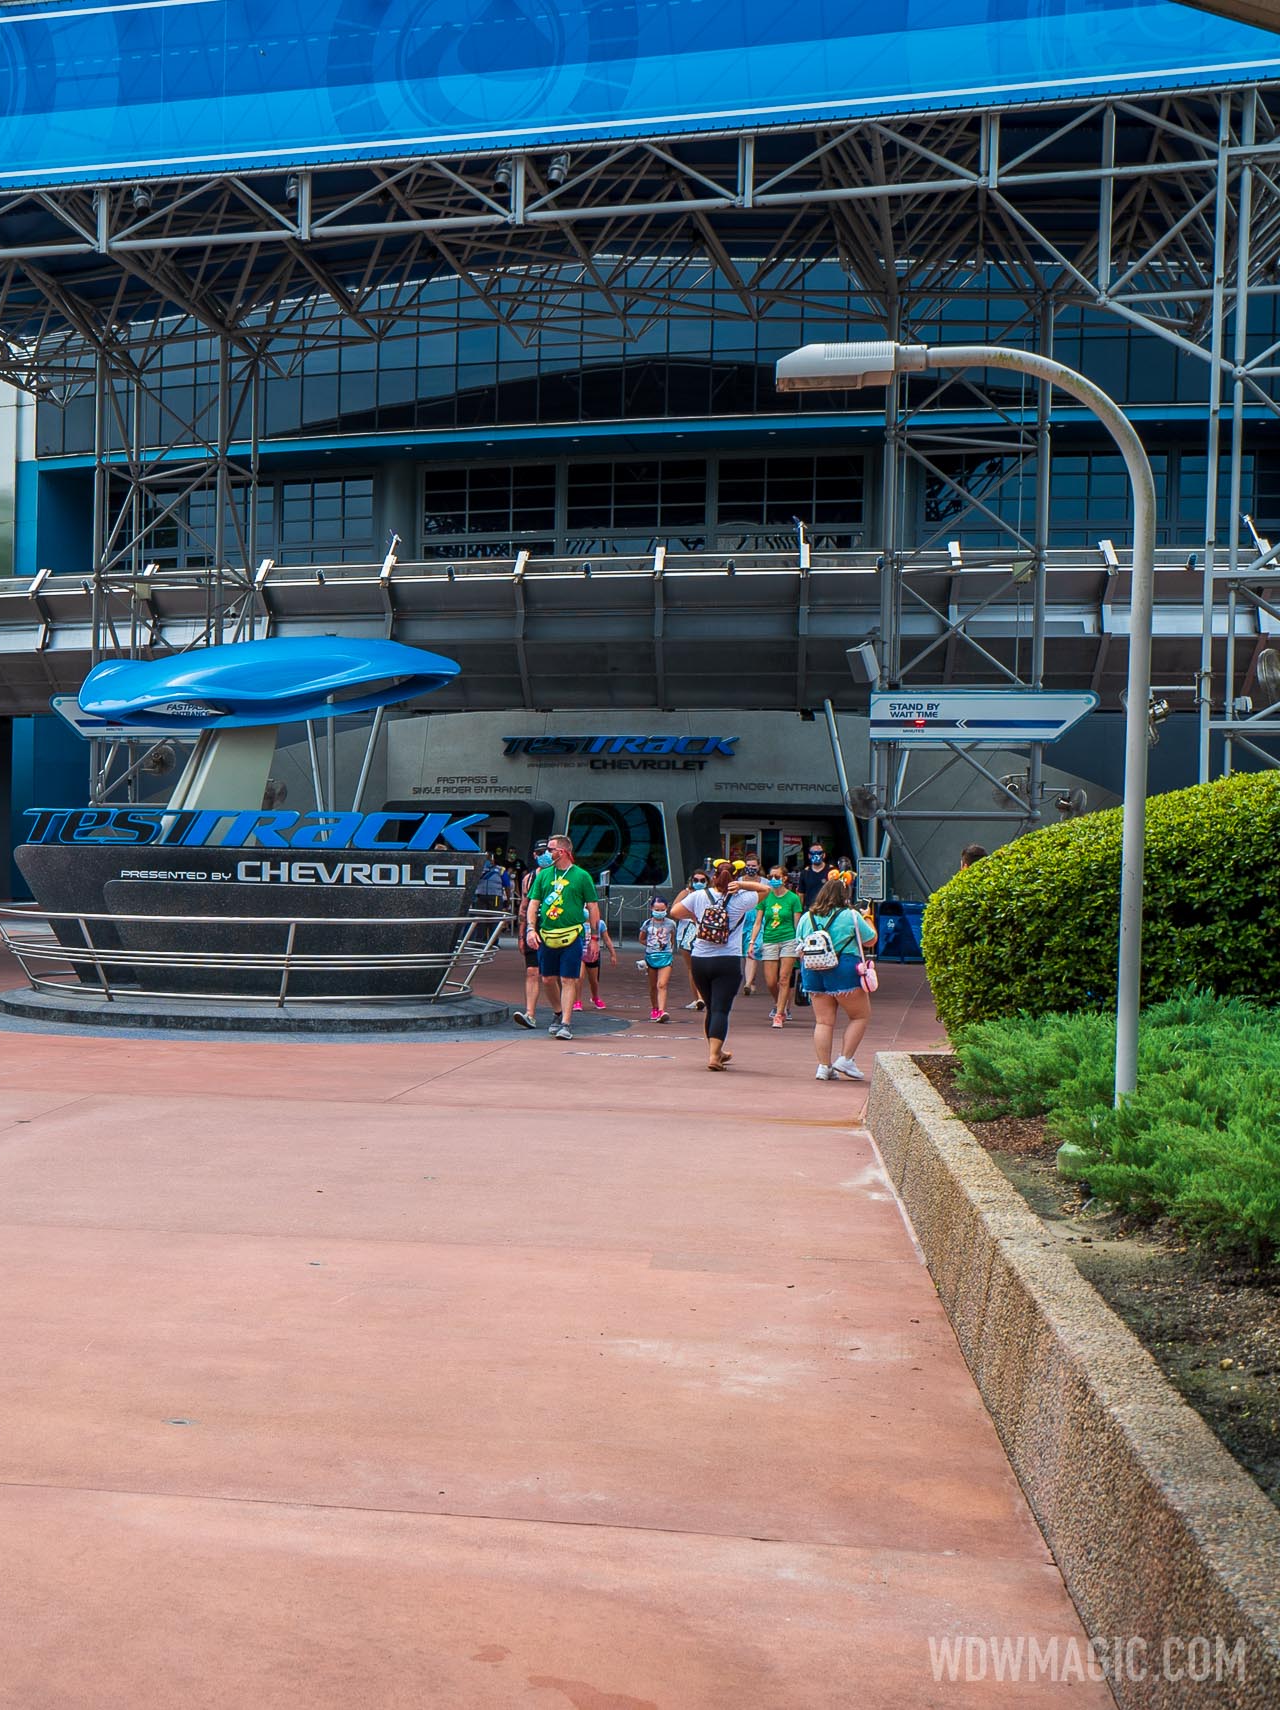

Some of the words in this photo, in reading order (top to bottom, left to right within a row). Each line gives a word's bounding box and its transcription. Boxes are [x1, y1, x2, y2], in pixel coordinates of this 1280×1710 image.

[167, 703, 208, 711] FASTPA
[888, 703, 923, 711] STAND
[926, 703, 940, 711] BY
[589, 759, 708, 771] CHEVROLET
[436, 776, 487, 784] FASTPASS
[412, 786, 441, 794] SINGLE
[443, 786, 471, 794] RIDER
[474, 786, 532, 794] ENTRANCE
[714, 782, 774, 792] STANDBY
[776, 783, 839, 792] ENTRANCE
[120, 870, 207, 880] PRESENTED
[211, 871, 232, 881] BY
[237, 861, 474, 886] CHEVROLET
